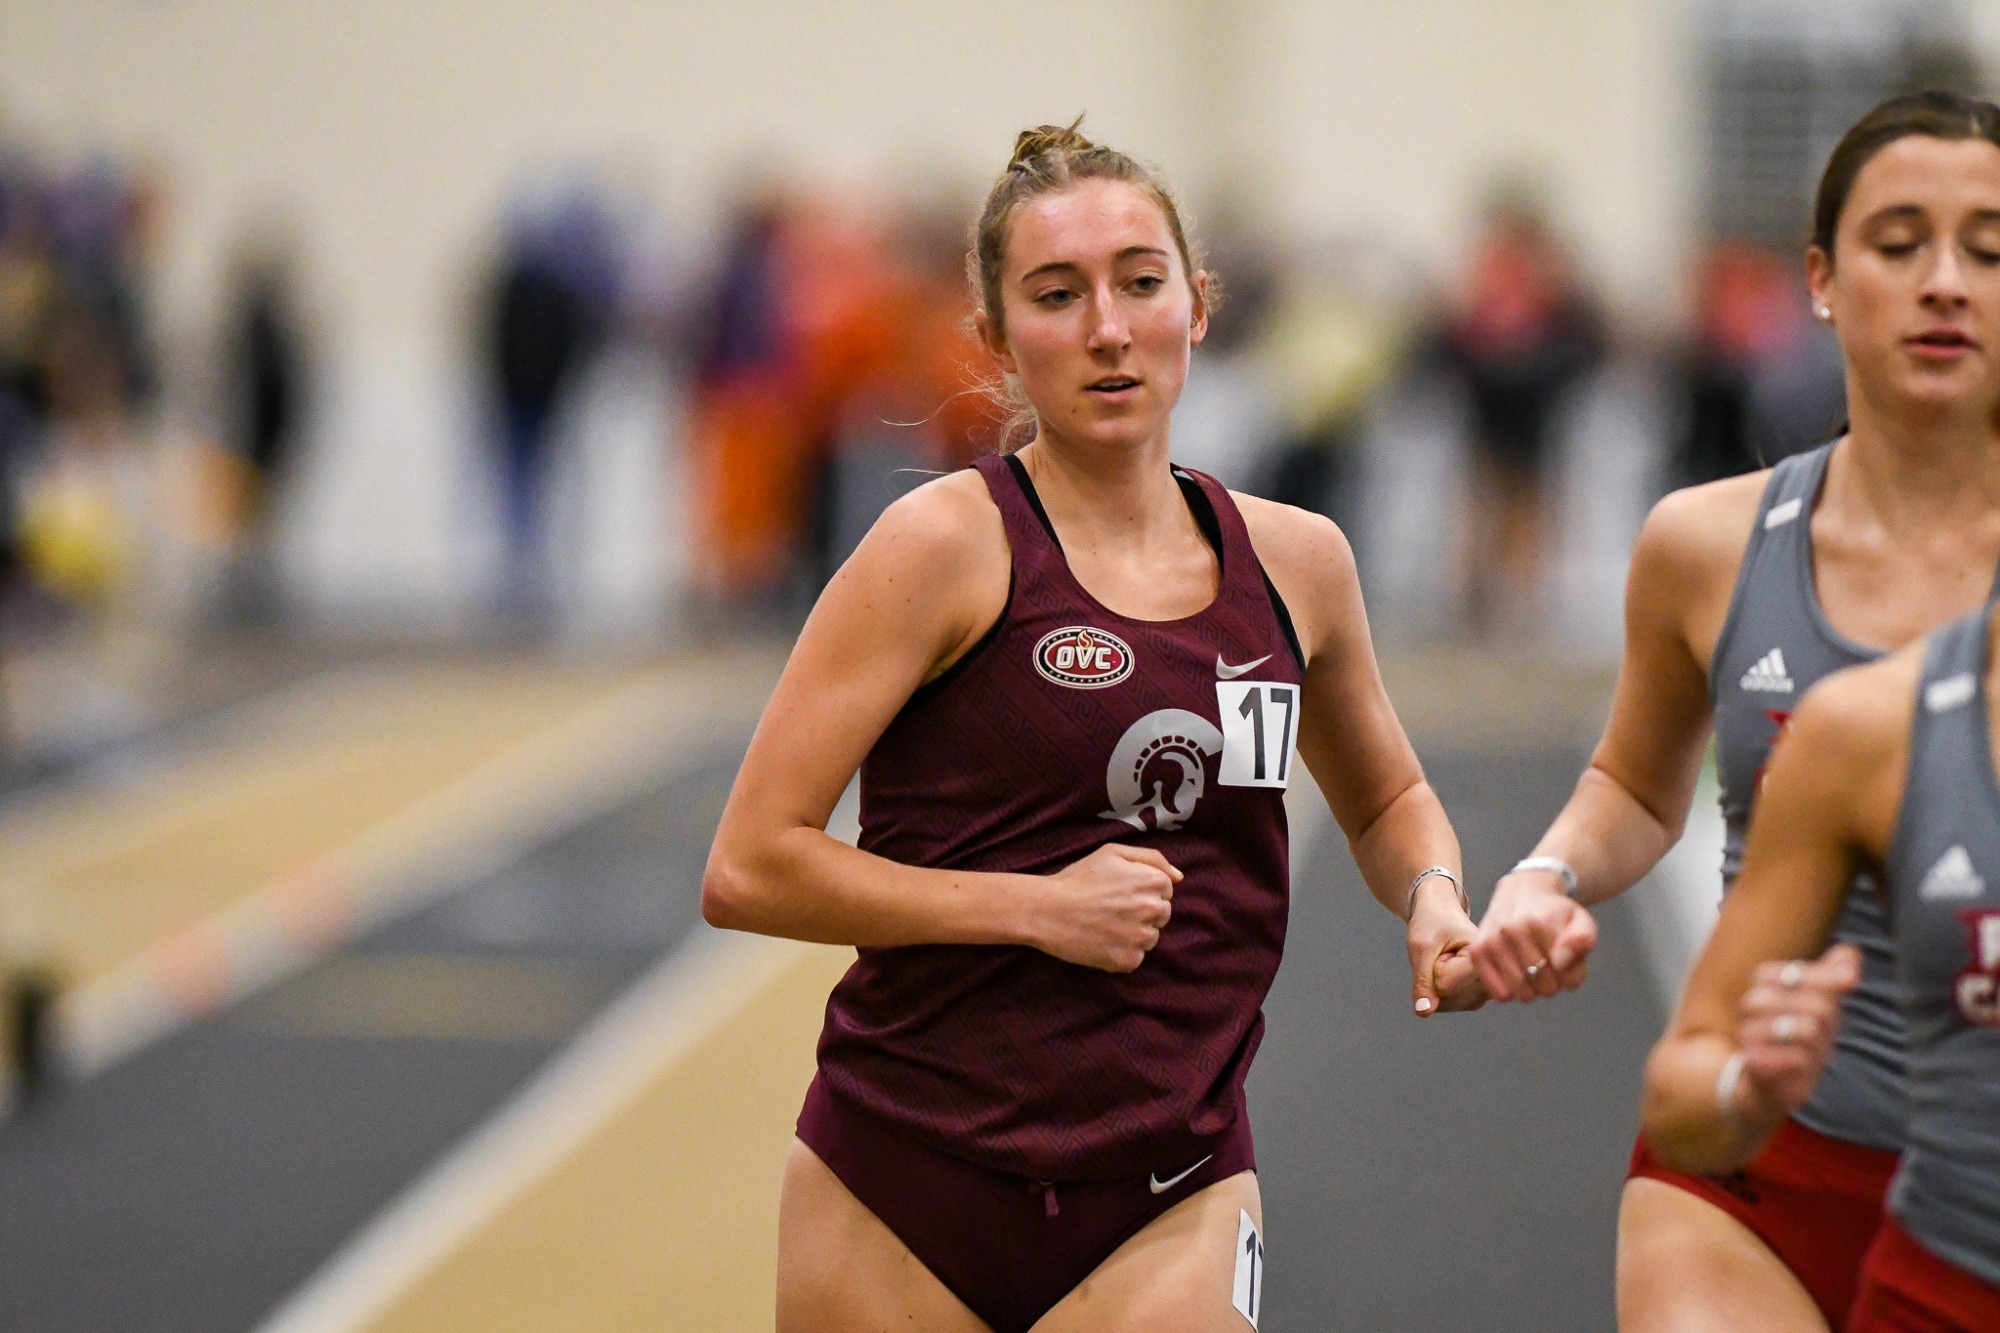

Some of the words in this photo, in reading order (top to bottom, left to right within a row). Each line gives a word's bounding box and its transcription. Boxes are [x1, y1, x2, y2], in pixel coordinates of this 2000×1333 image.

[1055, 645, 1112, 670] OVC
[1238, 687, 1293, 781] 17
[1246, 1230, 1263, 1320] 1
